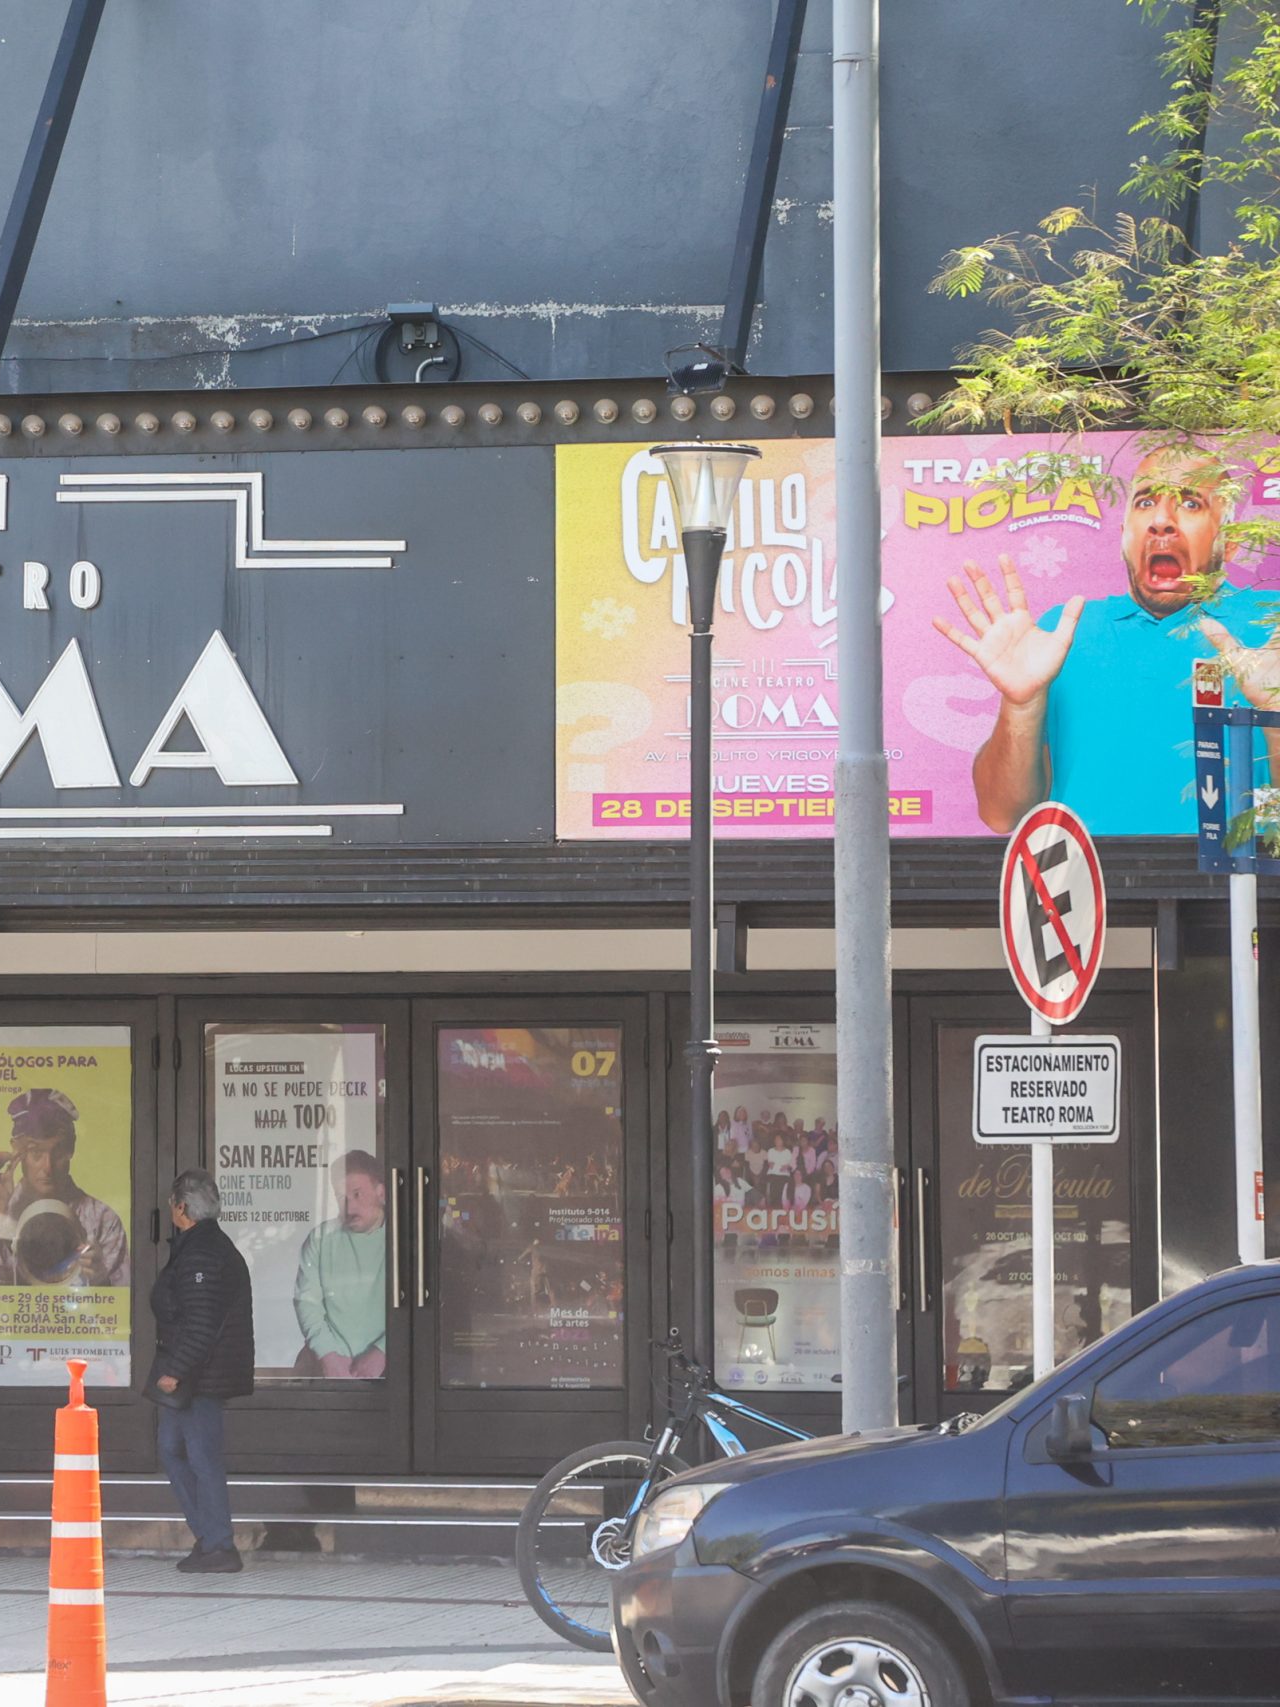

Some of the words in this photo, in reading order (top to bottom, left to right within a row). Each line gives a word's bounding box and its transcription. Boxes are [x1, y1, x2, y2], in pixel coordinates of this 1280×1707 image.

[904, 478, 1102, 534] PIOLA
[712, 676, 750, 688] CINE
[756, 675, 815, 688] TEATRO
[644, 750, 667, 762] AV
[676, 749, 758, 762] HLITO
[769, 749, 840, 761] YRIGOY
[600, 800, 643, 819] 28
[655, 799, 692, 818] DE
[712, 797, 922, 818] SEPTIERE
[58, 1055, 98, 1068] PARA
[571, 1050, 617, 1077] 07
[986, 1055, 1110, 1073] ESTACIONAMIENTO
[229, 1064, 253, 1073] LUCAS
[256, 1064, 287, 1073] UPSTEIN
[289, 1064, 300, 1072] EN
[222, 1082, 236, 1097] YA
[242, 1082, 258, 1097] NO
[264, 1082, 280, 1097] SE
[284, 1081, 323, 1097] PUEDE
[329, 1081, 368, 1097] DECIR
[1010, 1080, 1088, 1098] RESERVADO
[255, 1109, 288, 1129] NADA
[293, 1104, 336, 1130] TODO
[1002, 1105, 1056, 1124] TEATRO
[1059, 1105, 1095, 1123] ROMA
[219, 1144, 256, 1169] SAN
[261, 1144, 329, 1169] RAFAEL
[219, 1174, 246, 1190] CINE
[249, 1174, 292, 1190] TEATRO
[959, 1164, 993, 1198] de
[220, 1191, 254, 1207] ROMA
[220, 1211, 248, 1223] JUEVES
[250, 1211, 261, 1223] 12
[262, 1211, 273, 1222] DE
[274, 1210, 310, 1222] OCTUBRE
[549, 1207, 585, 1216] Instituto
[721, 1201, 840, 1232] Parusí
[549, 1216, 592, 1224] Profesorado
[594, 1216, 604, 1224] de
[605, 1216, 622, 1224] Arte
[794, 1266, 836, 1278] almas
[18, 1293, 32, 1303] 29
[35, 1292, 50, 1304] de
[53, 1292, 115, 1304] setiembre
[18, 1303, 31, 1313] 21
[35, 1303, 49, 1313] 30
[52, 1302, 69, 1314] hs.
[550, 1307, 572, 1318] Mes
[574, 1307, 590, 1318] de
[13, 1313, 51, 1324] ROMA
[54, 1313, 76, 1324] San
[79, 1313, 118, 1325] Rafael
[550, 1318, 564, 1328] las
[565, 1319, 590, 1328] artes
[49, 1348, 70, 1356] LUIS
[71, 1348, 125, 1356] TROMBETTA
